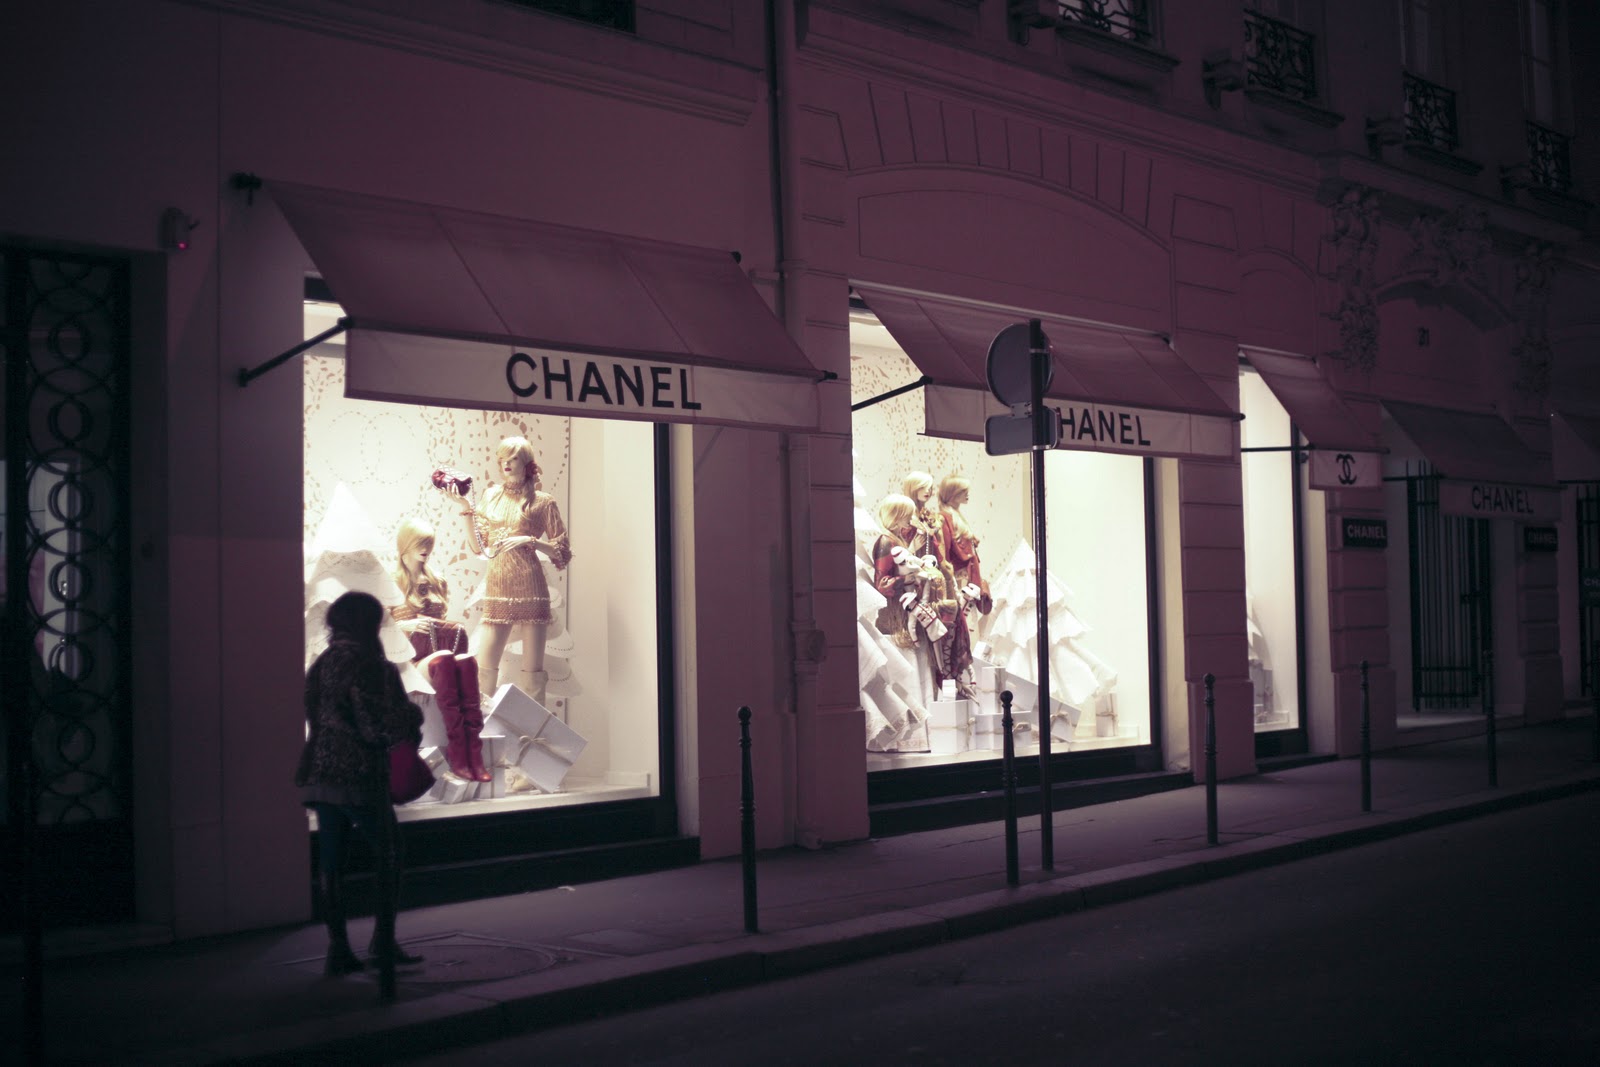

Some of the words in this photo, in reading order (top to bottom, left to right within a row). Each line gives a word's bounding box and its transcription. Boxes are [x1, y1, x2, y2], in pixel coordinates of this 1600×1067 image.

[505, 352, 702, 411] CHANEL
[1056, 406, 1151, 446] HANEL
[1471, 485, 1534, 513] CHANEL
[1346, 523, 1387, 539] CHANEL
